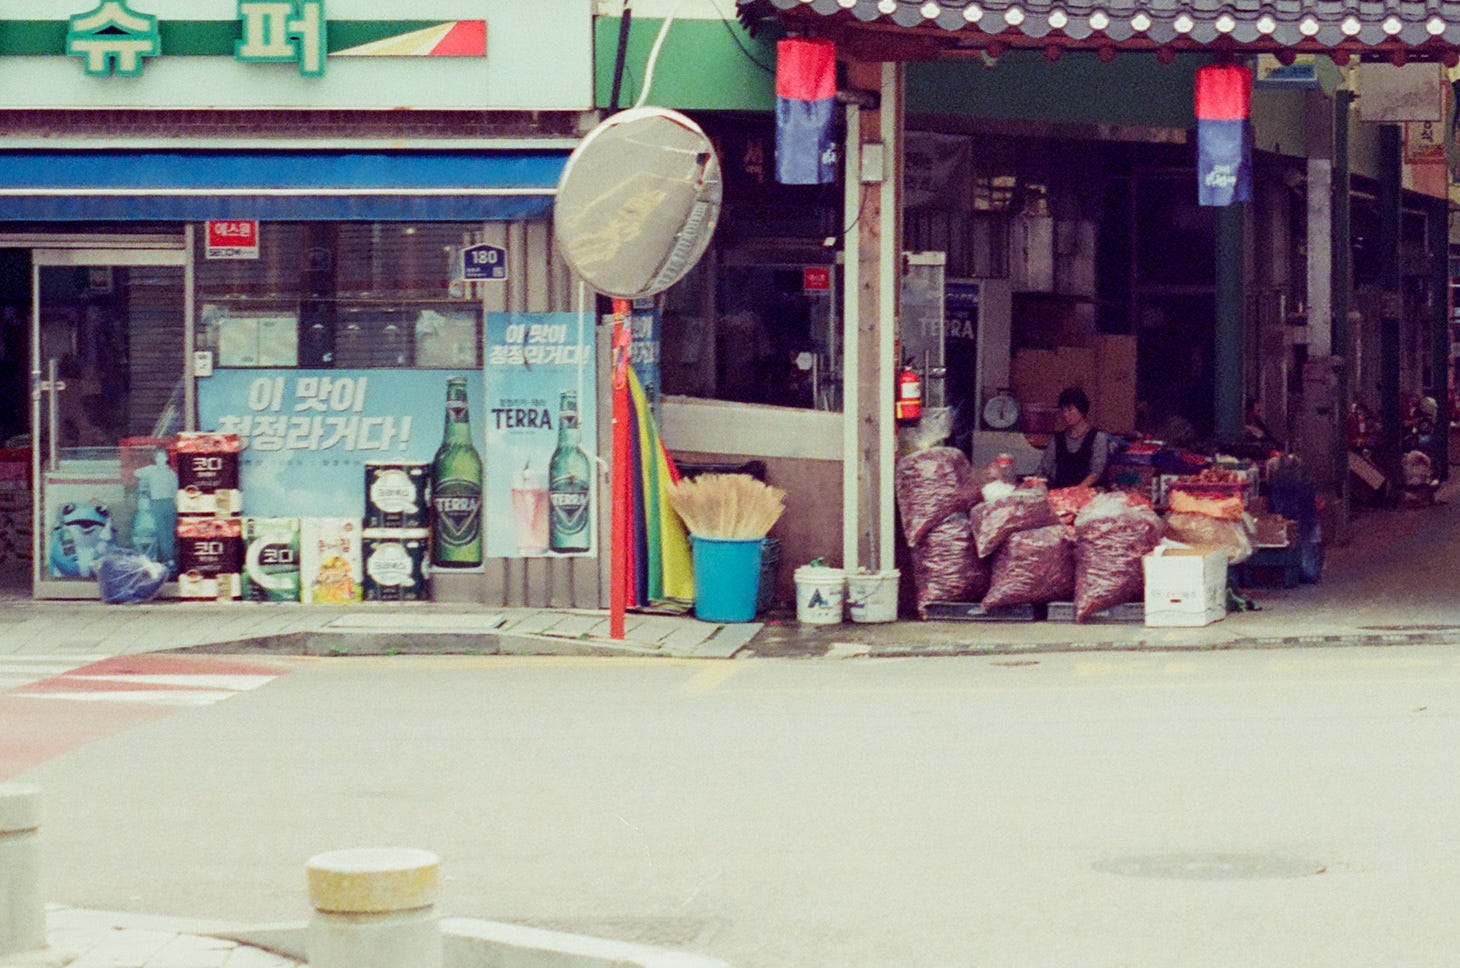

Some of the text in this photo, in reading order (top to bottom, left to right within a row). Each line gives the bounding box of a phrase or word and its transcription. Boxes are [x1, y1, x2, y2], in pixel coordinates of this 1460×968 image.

[472, 250, 498, 264] 180
[249, 376, 368, 412] 이 맛이
[492, 408, 553, 430] TERRA
[434, 497, 479, 512] TERRA
